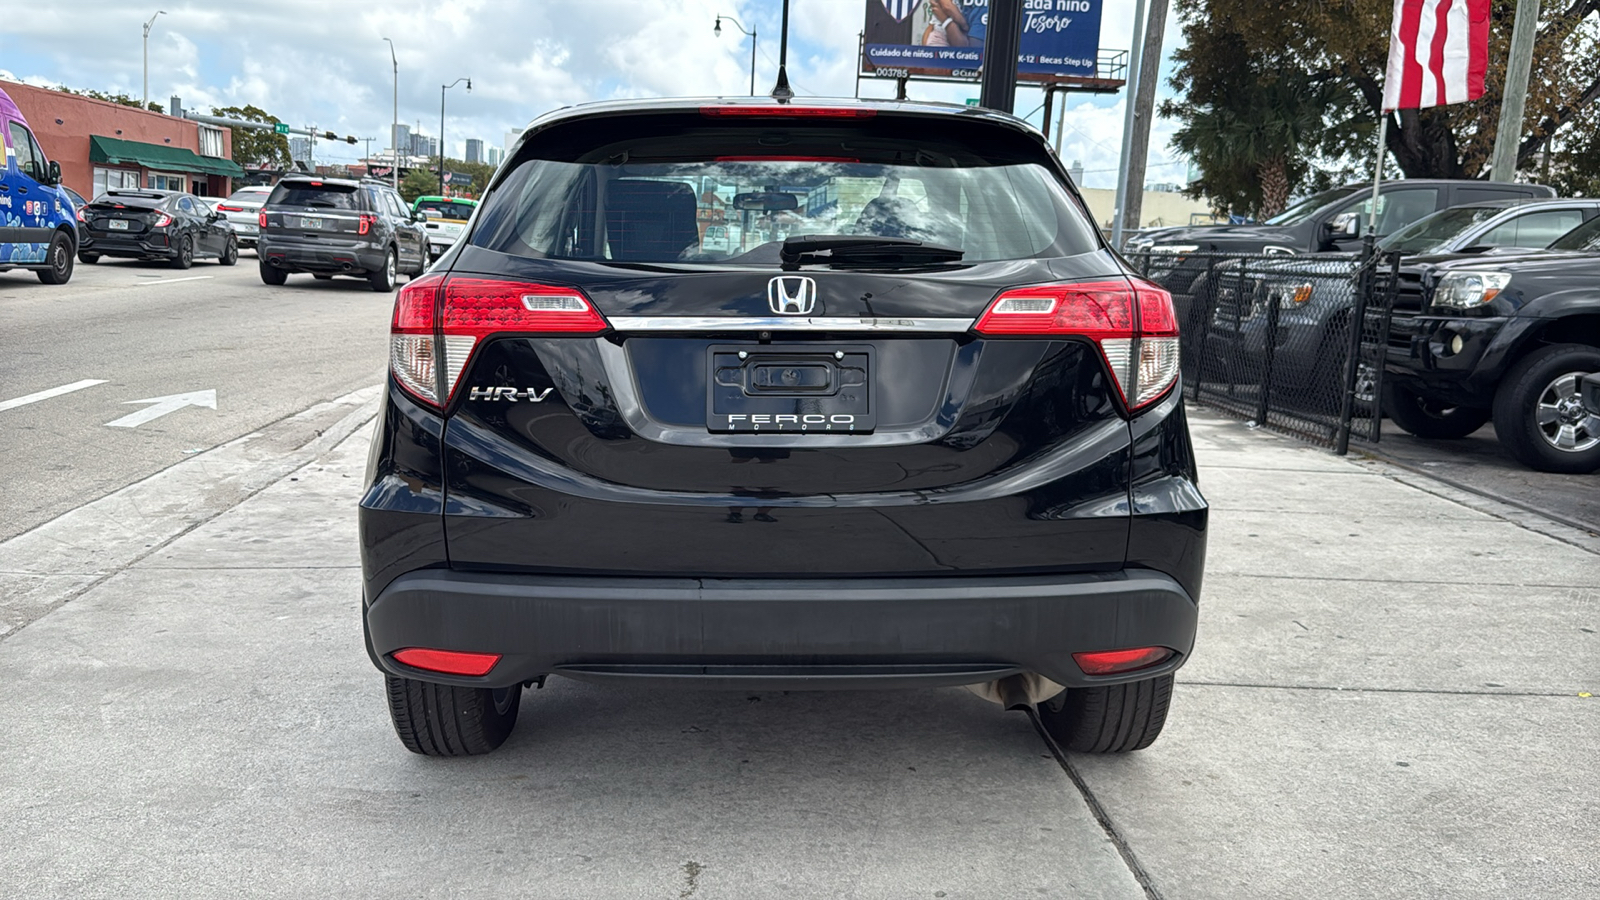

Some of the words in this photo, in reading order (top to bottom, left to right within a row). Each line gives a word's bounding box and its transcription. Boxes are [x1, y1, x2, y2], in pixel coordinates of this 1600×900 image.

[1023, 0, 1052, 10] ada
[1023, 11, 1073, 33] Tesoro
[870, 47, 901, 57] Cuidado
[902, 48, 912, 58] de
[913, 48, 934, 59] niños
[939, 51, 955, 59] VPK
[956, 52, 979, 60] Gratis
[1018, 55, 1035, 63] K-12
[1040, 56, 1062, 65] Becas
[1063, 57, 1081, 67] Step
[1082, 58, 1093, 68] Up
[876, 67, 908, 78] 003785
[469, 386, 554, 402] HR-V
[728, 414, 854, 424] FERCO
